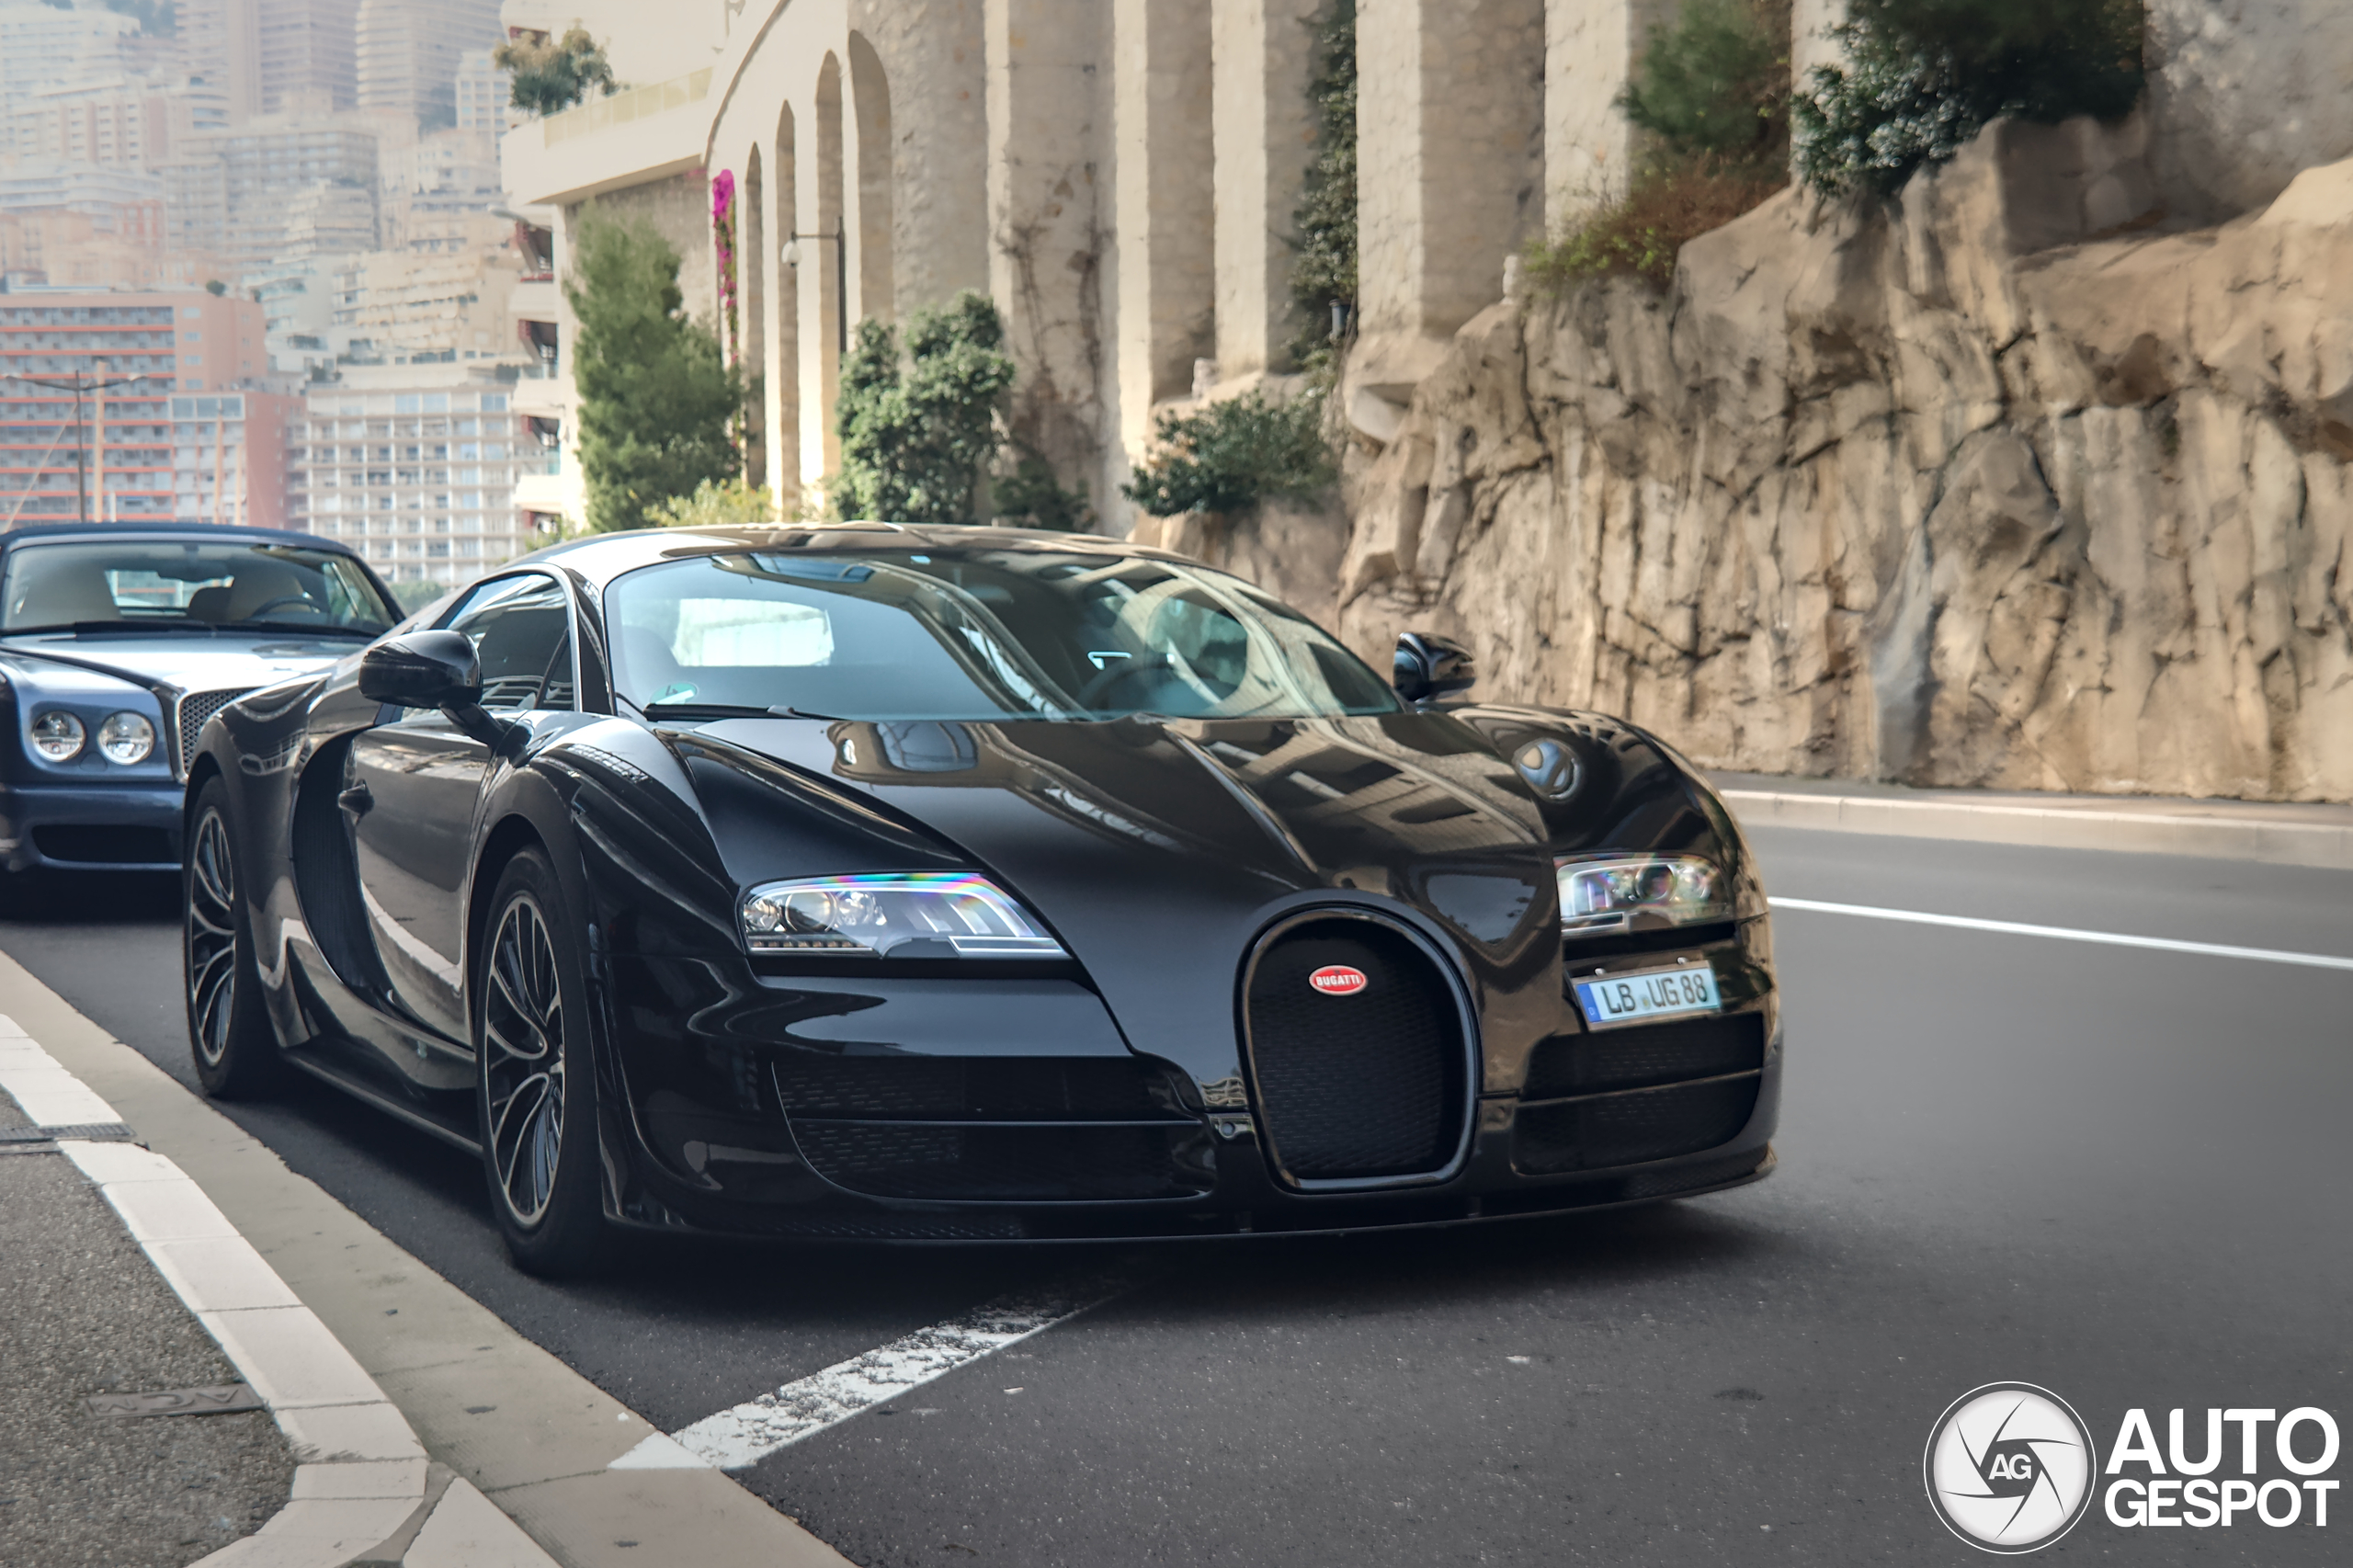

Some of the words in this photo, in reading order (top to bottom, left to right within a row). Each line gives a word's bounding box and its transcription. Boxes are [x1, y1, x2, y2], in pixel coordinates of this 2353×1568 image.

[1315, 975, 1360, 987] BUGATTI
[1600, 983, 1636, 1014] LB
[1645, 977, 1680, 1007] UG
[1679, 973, 1708, 1005] 88
[96, 1388, 239, 1414] ACM
